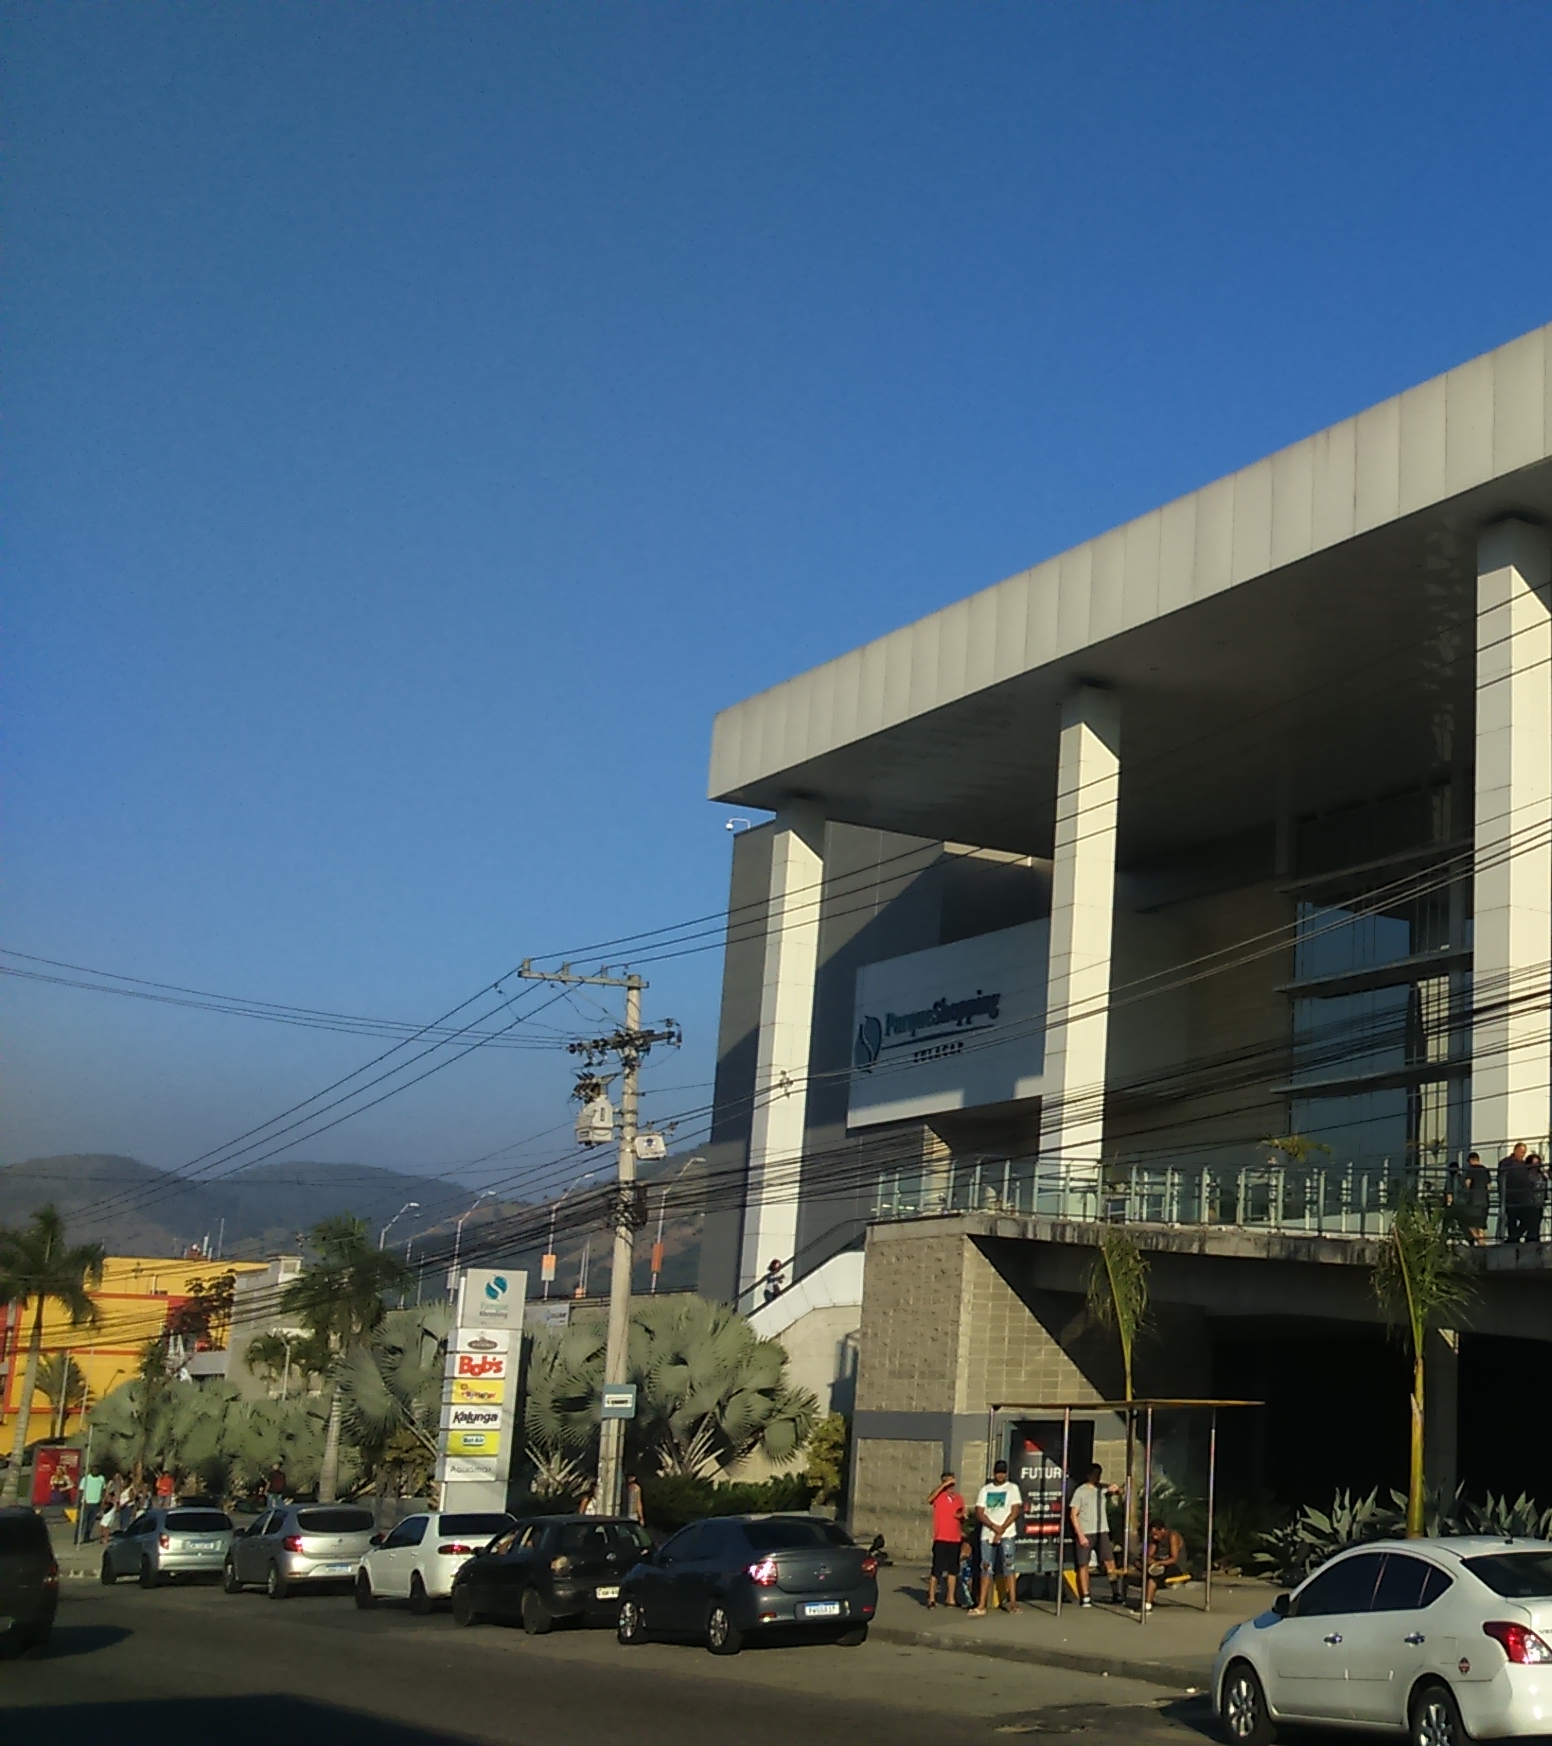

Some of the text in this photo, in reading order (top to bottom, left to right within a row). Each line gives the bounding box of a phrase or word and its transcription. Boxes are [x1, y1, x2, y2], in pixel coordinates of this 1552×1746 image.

[459, 1355, 503, 1377] Bob's
[452, 1411, 498, 1424] Kalunga
[1020, 1466, 1069, 1480] FUTUR
